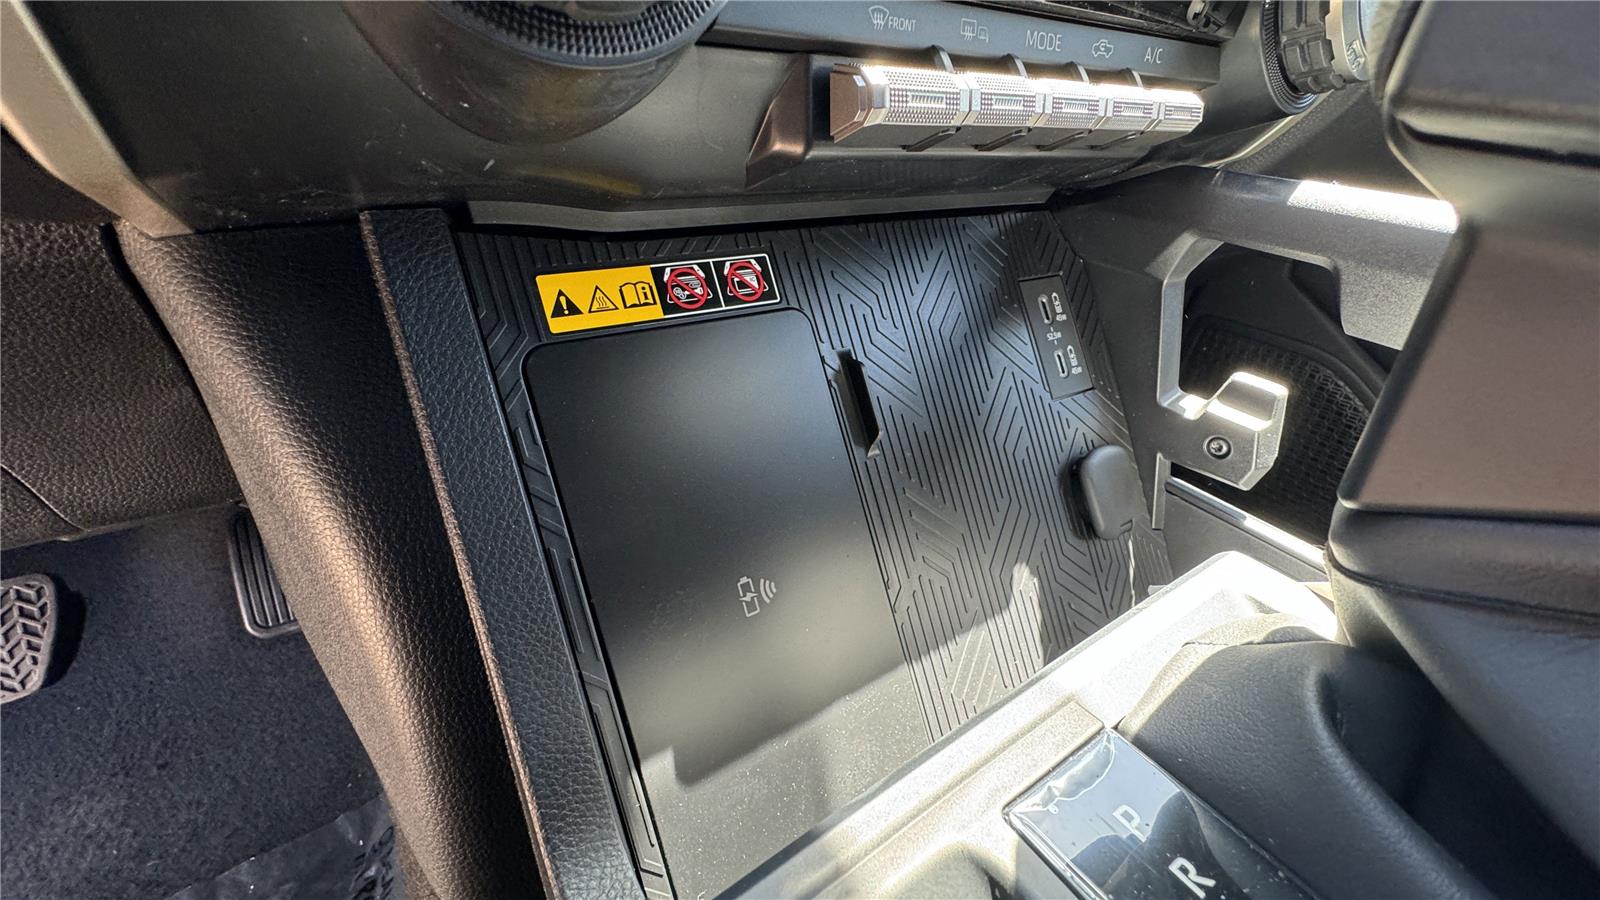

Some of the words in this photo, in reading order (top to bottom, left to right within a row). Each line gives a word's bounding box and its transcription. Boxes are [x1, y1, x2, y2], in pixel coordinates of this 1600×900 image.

[888, 16, 917, 33] FRONT
[1025, 29, 1063, 52] MODE
[1143, 47, 1163, 64] A/C
[1112, 804, 1147, 843] P
[1168, 856, 1216, 899] R
